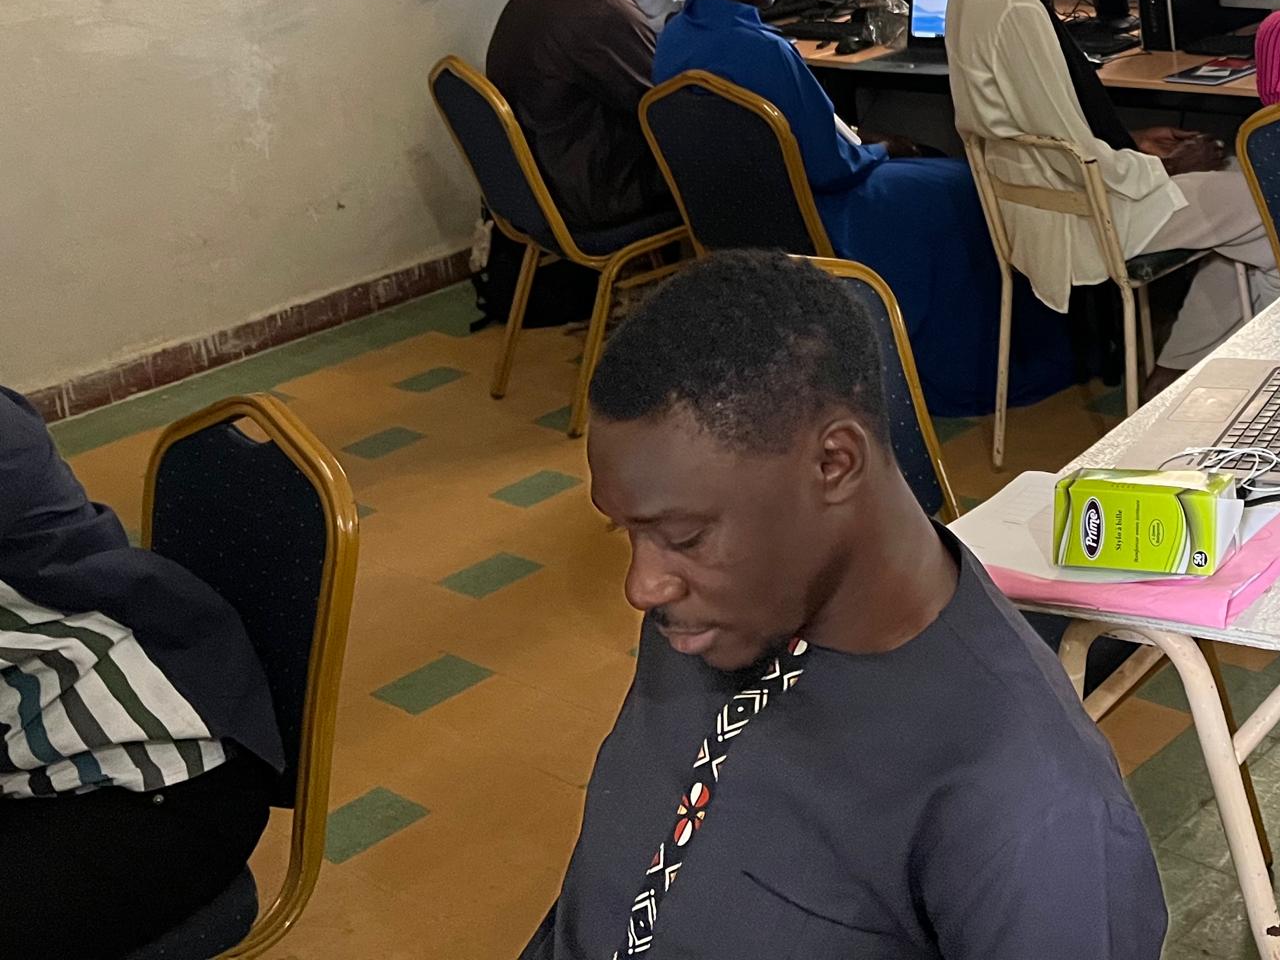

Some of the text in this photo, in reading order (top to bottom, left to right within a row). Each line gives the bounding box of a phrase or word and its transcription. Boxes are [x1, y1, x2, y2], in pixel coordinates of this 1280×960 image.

[1115, 509, 1123, 526] bille
[1085, 508, 1101, 548] Prime
[1115, 531, 1124, 552] Stylo
[1192, 553, 1202, 566] 50
